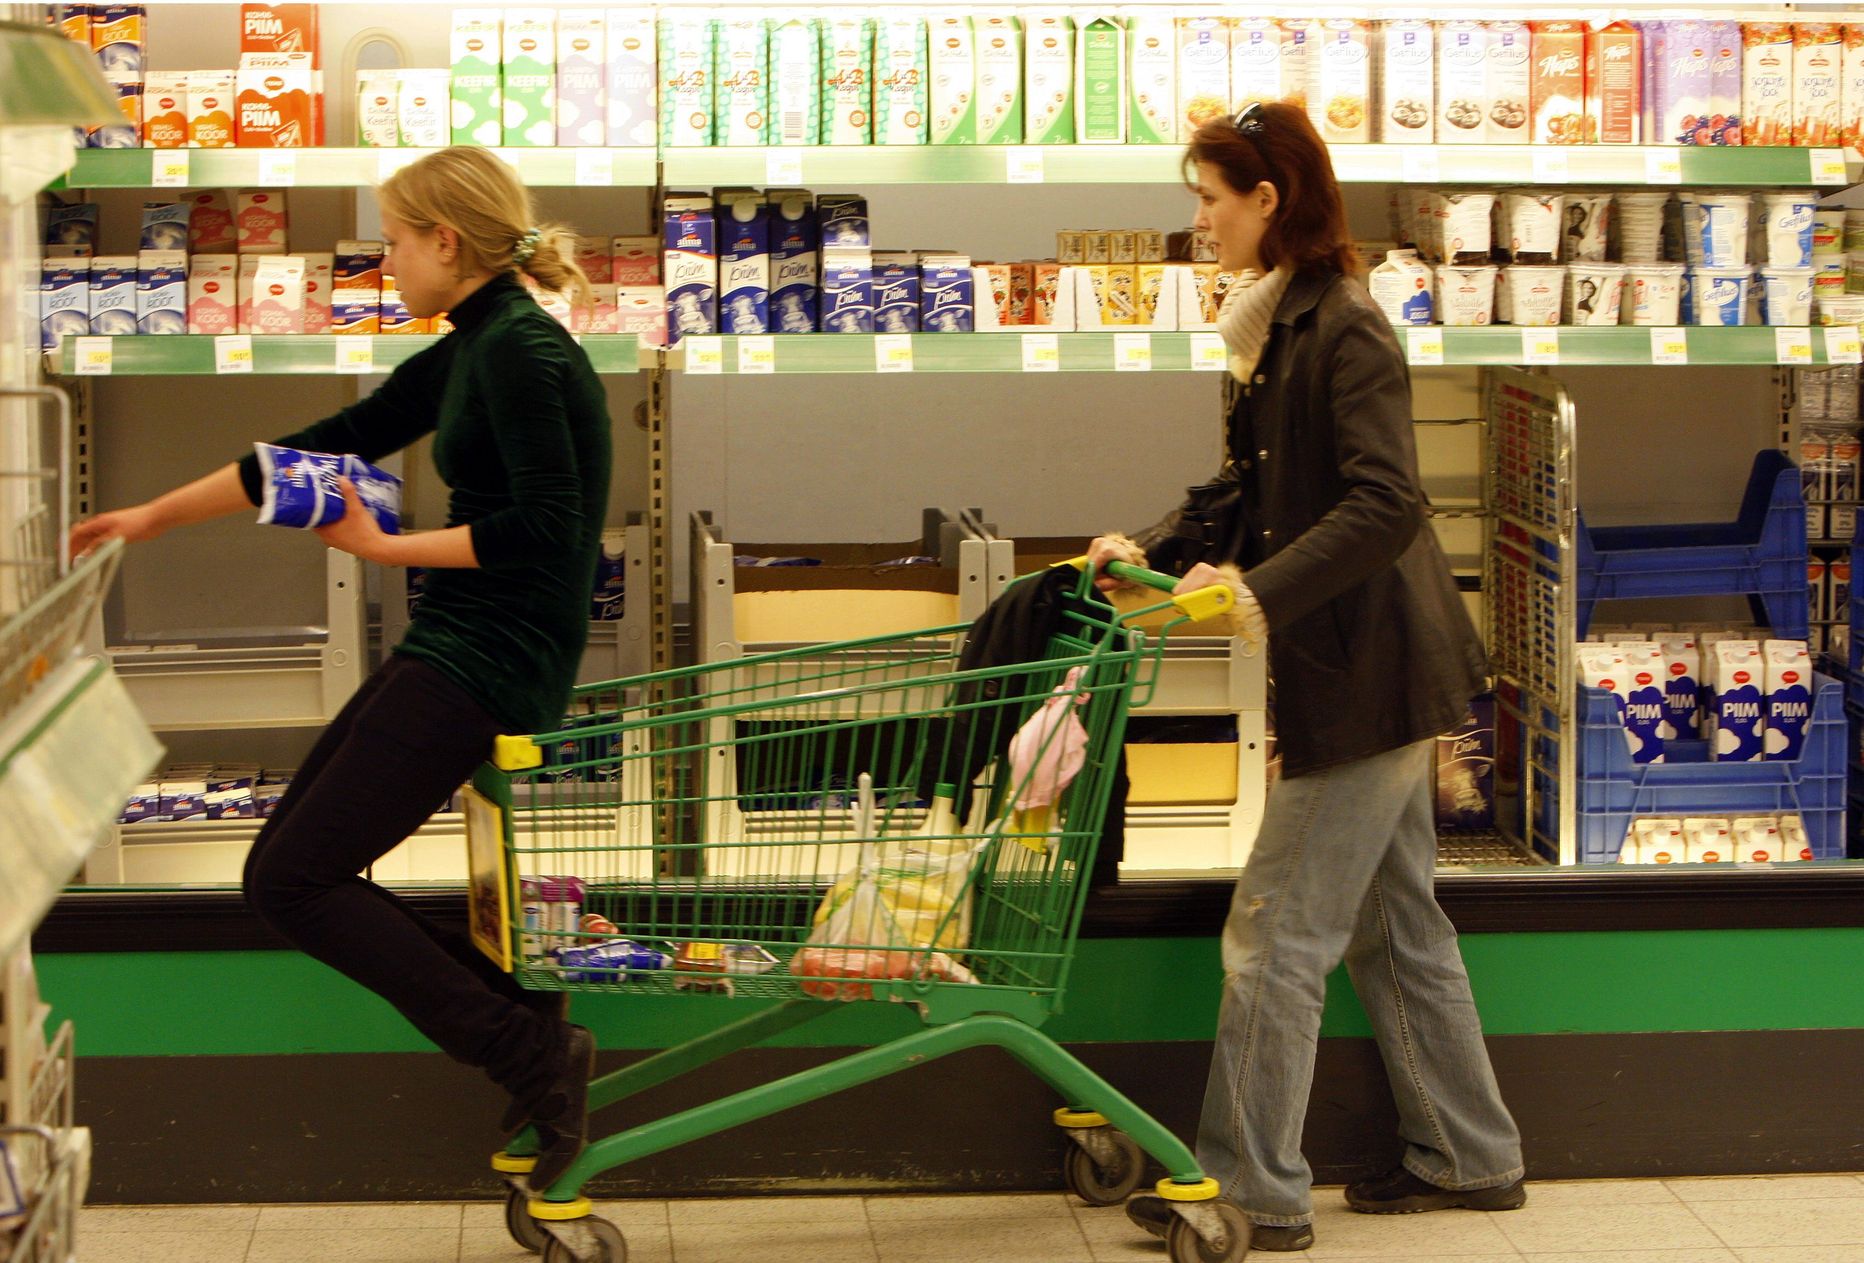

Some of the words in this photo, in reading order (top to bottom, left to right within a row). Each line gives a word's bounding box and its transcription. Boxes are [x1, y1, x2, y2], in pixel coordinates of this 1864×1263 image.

[245, 19, 283, 35] PIIM
[1184, 46, 1223, 57] Gefilus
[1237, 46, 1275, 57] Gefilus
[1487, 47, 1526, 59] Gefilus
[242, 110, 281, 127] PIIM
[1663, 693, 1696, 709] PIIM
[1626, 704, 1662, 719] PIIM
[1722, 702, 1759, 718] PIIM
[1771, 702, 1808, 717] PIIM
